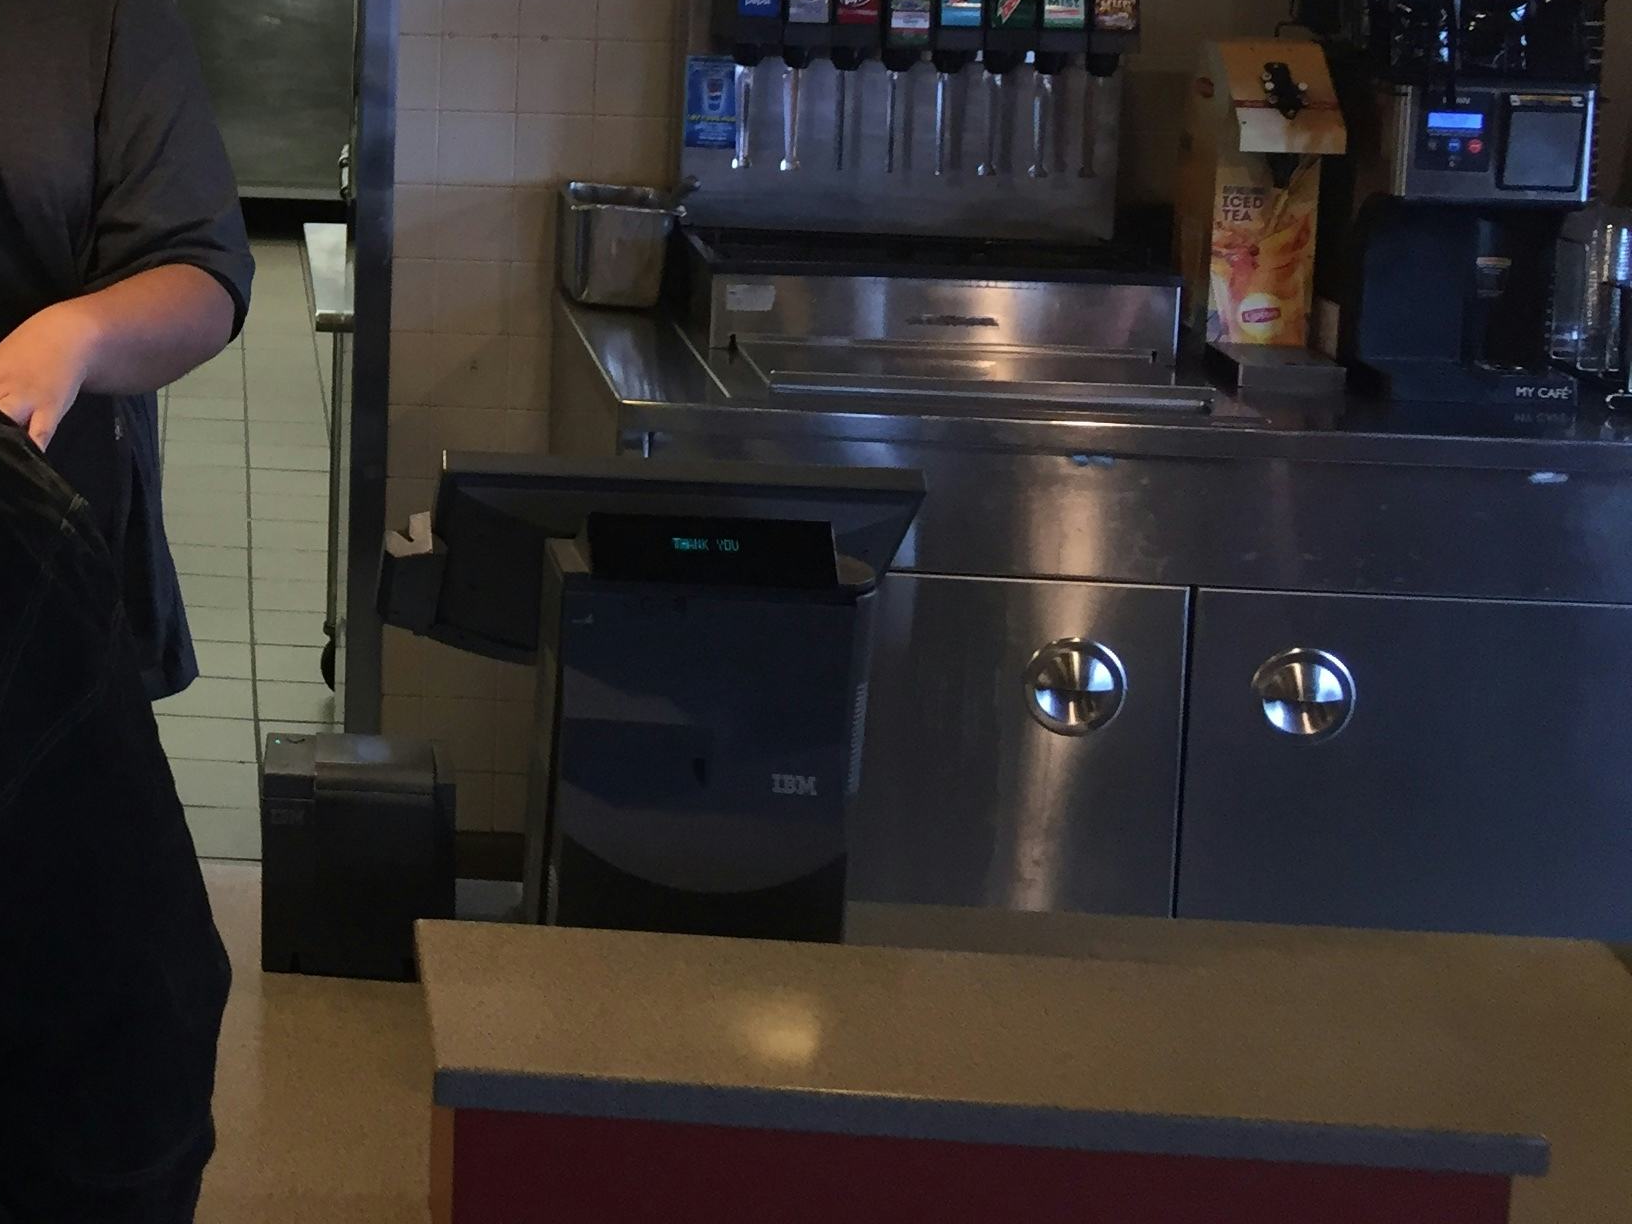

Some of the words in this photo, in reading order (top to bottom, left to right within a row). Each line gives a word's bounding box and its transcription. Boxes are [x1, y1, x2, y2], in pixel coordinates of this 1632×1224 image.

[1223, 196, 1264, 209] ICED
[1223, 209, 1252, 222] TEA
[1515, 386, 1533, 401] MY
[717, 539, 739, 551] YOU
[771, 774, 817, 796] IBM
